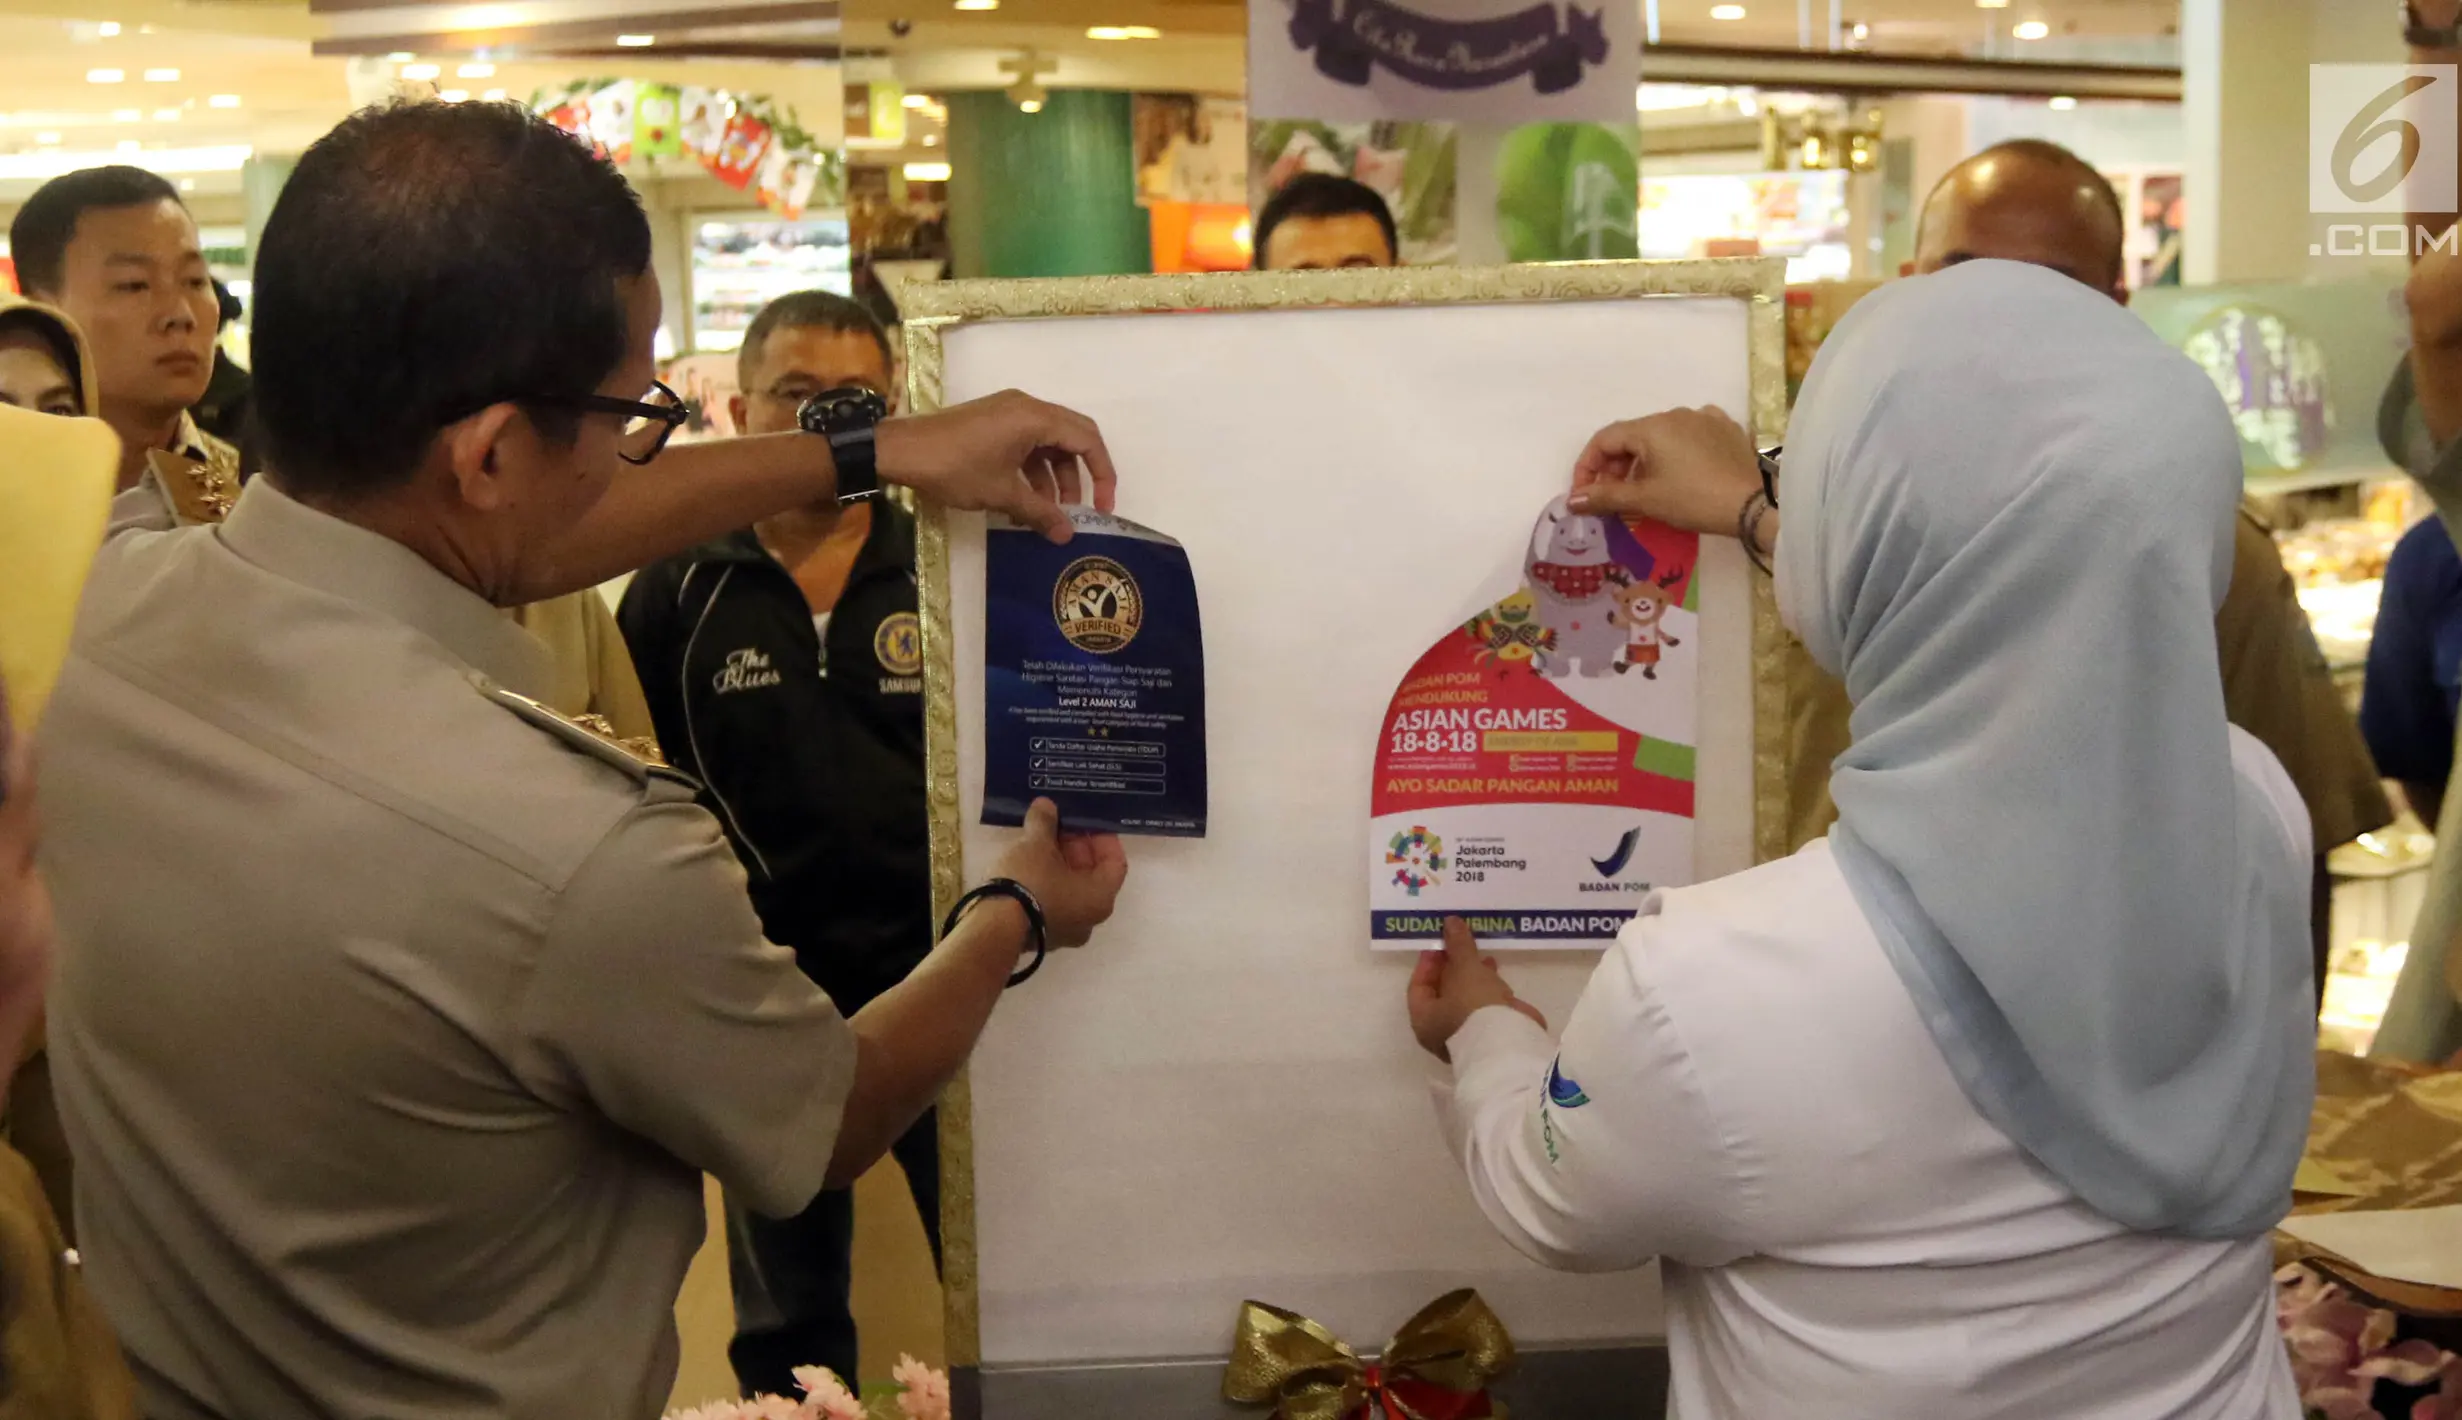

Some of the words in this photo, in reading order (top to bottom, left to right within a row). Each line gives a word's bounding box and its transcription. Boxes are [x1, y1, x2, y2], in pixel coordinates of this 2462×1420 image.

[1074, 621, 1122, 635] VERIFIED
[726, 648, 770, 667] The
[713, 662, 782, 695] Blues
[1446, 672, 1482, 685] POM
[1058, 697, 1080, 707] Level
[1081, 698, 1088, 707] 2
[1089, 698, 1117, 708] AMAN
[1118, 699, 1137, 709] SAJI
[1392, 708, 1469, 732] ASIAN
[1474, 707, 1567, 730] GAMES
[1387, 778, 1423, 793] AYO
[1427, 778, 1484, 793] SADAR
[1487, 778, 1560, 793] PANGAN
[1565, 778, 1619, 793] AMAN
[1456, 845, 1505, 856] Jakarta
[1456, 857, 1527, 871] Palembang
[1455, 871, 1485, 882] 2018
[1579, 882, 1620, 892] BADAN
[1623, 882, 1650, 892] POM
[1466, 916, 1516, 932] IBINA
[1520, 916, 1585, 932] BADAN
